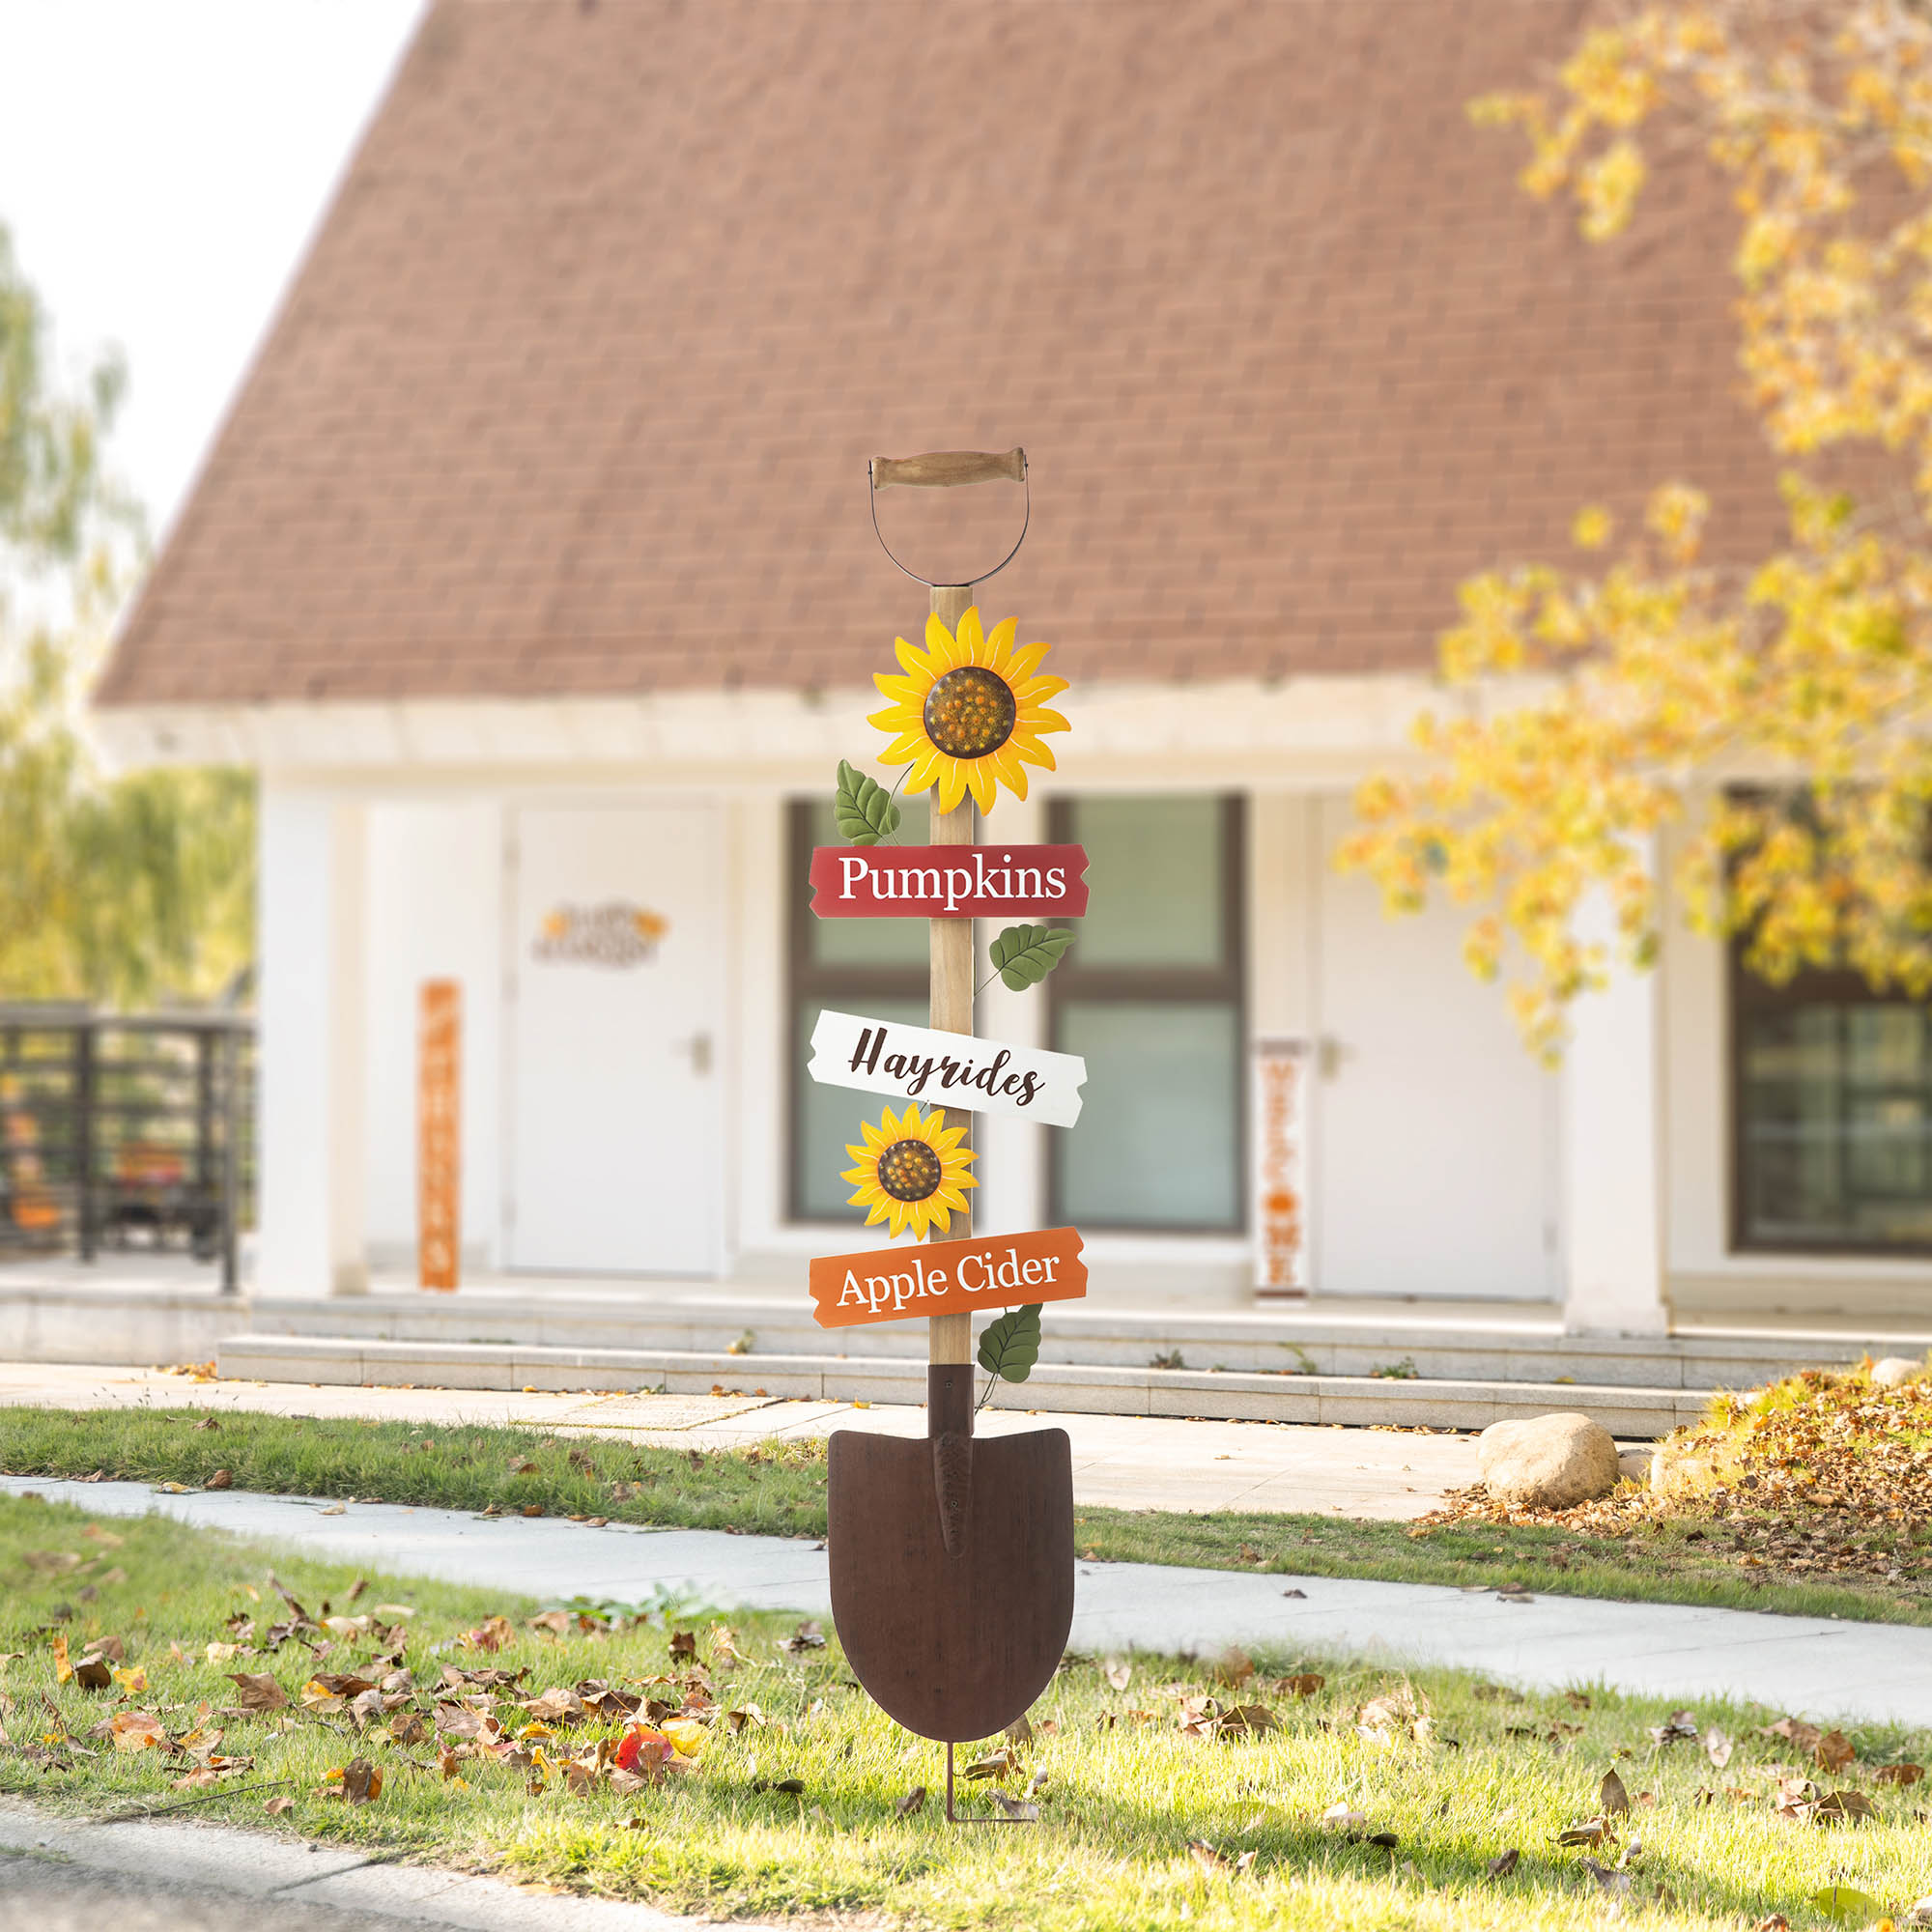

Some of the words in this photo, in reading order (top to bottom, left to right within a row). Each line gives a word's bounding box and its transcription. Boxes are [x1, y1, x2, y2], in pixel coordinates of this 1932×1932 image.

[838, 854, 1066, 911] Pumpkins
[847, 1027, 1046, 1107] Hayrides
[836, 1259, 949, 1314] Apple
[956, 1248, 1060, 1293] Cider
